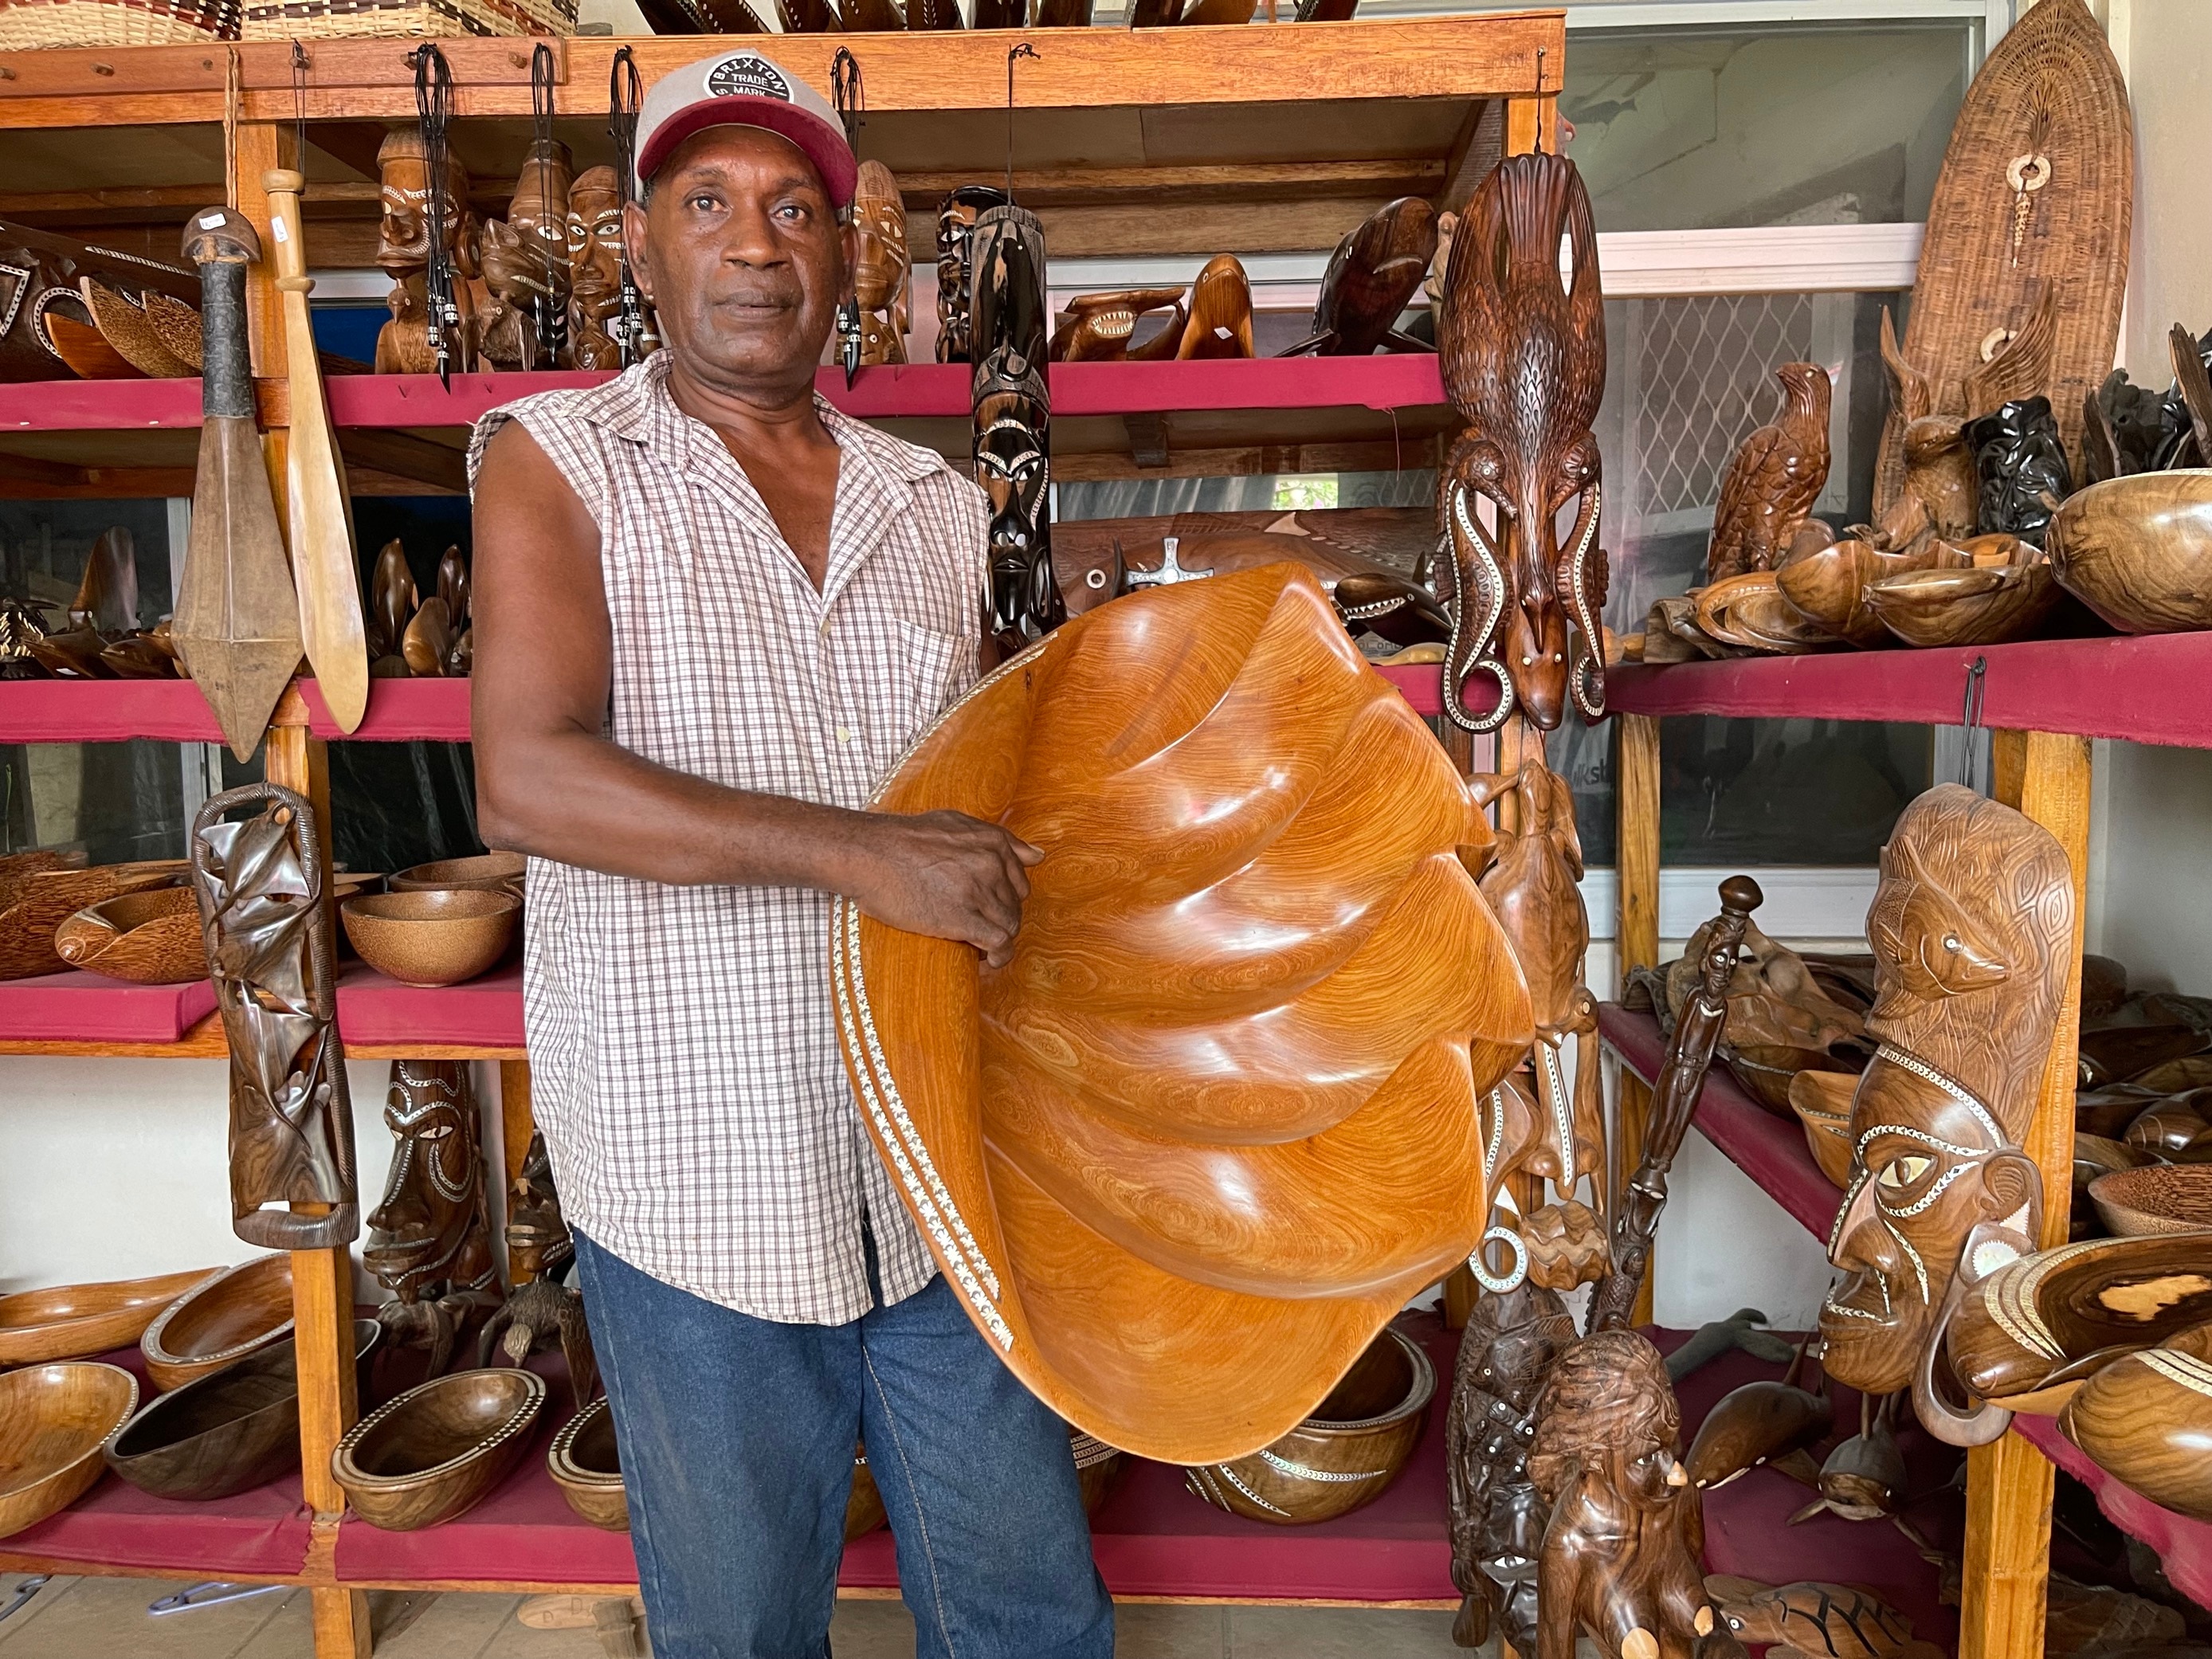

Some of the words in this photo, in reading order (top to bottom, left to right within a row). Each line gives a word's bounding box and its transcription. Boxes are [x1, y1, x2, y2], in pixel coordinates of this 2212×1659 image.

[713, 58, 786, 90] BRIXTON
[731, 73, 769, 87] TRADE
[734, 85, 766, 97] MARK
